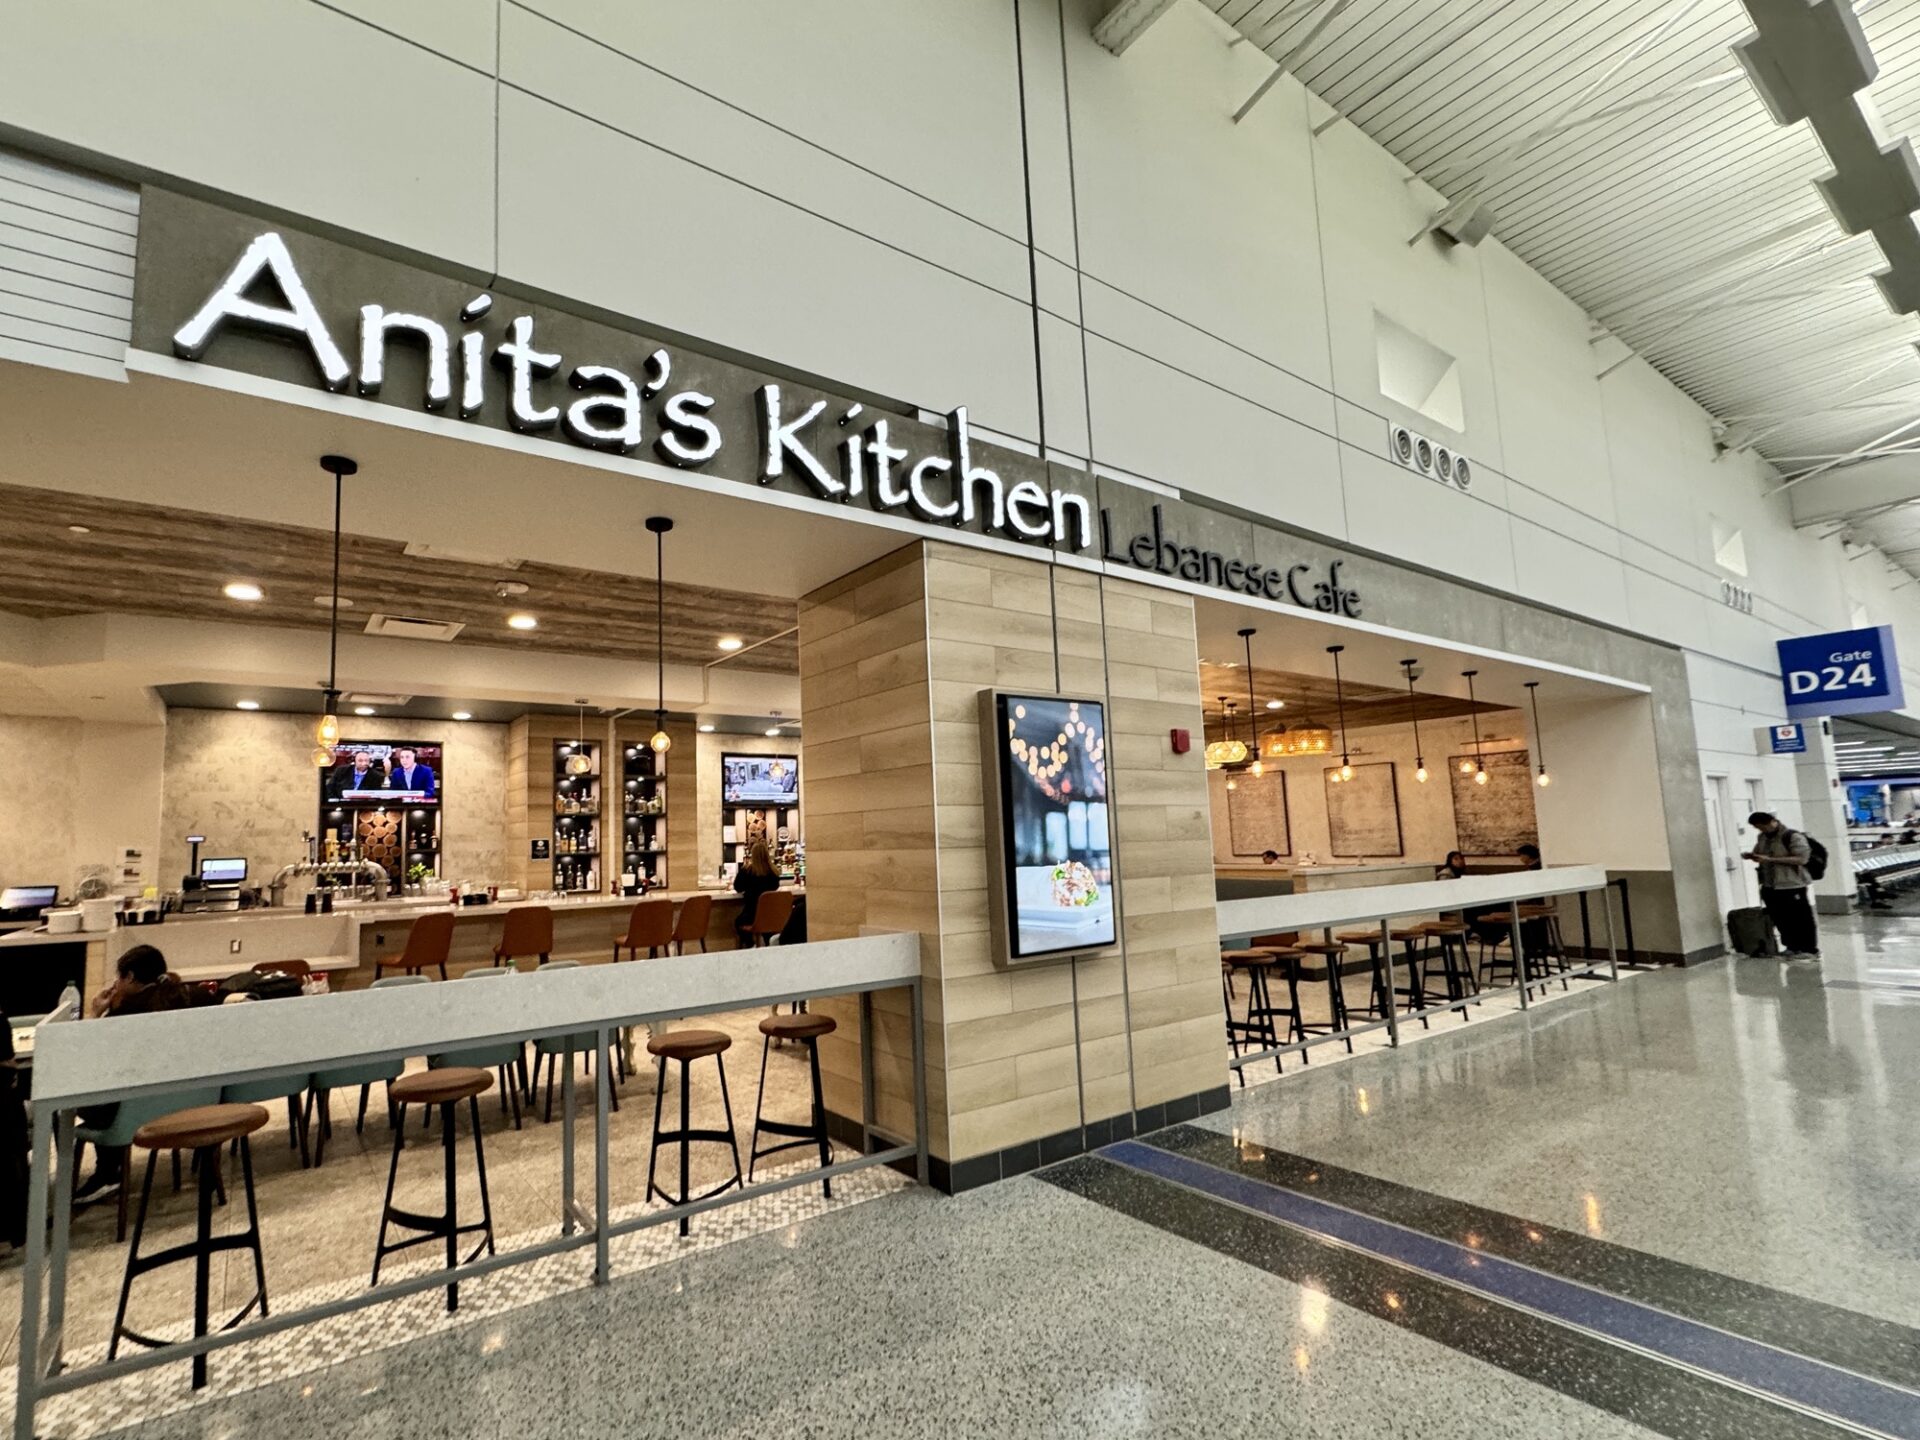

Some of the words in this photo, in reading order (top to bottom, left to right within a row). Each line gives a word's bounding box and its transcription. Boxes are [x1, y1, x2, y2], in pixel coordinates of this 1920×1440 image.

[173, 231, 723, 467] Anita's
[755, 384, 1092, 553] Kitchen
[1103, 504, 1285, 600] Lebanese
[1286, 558, 1362, 620] Cafe
[1789, 662, 1877, 695] D24
[1829, 650, 1873, 663] Gate
